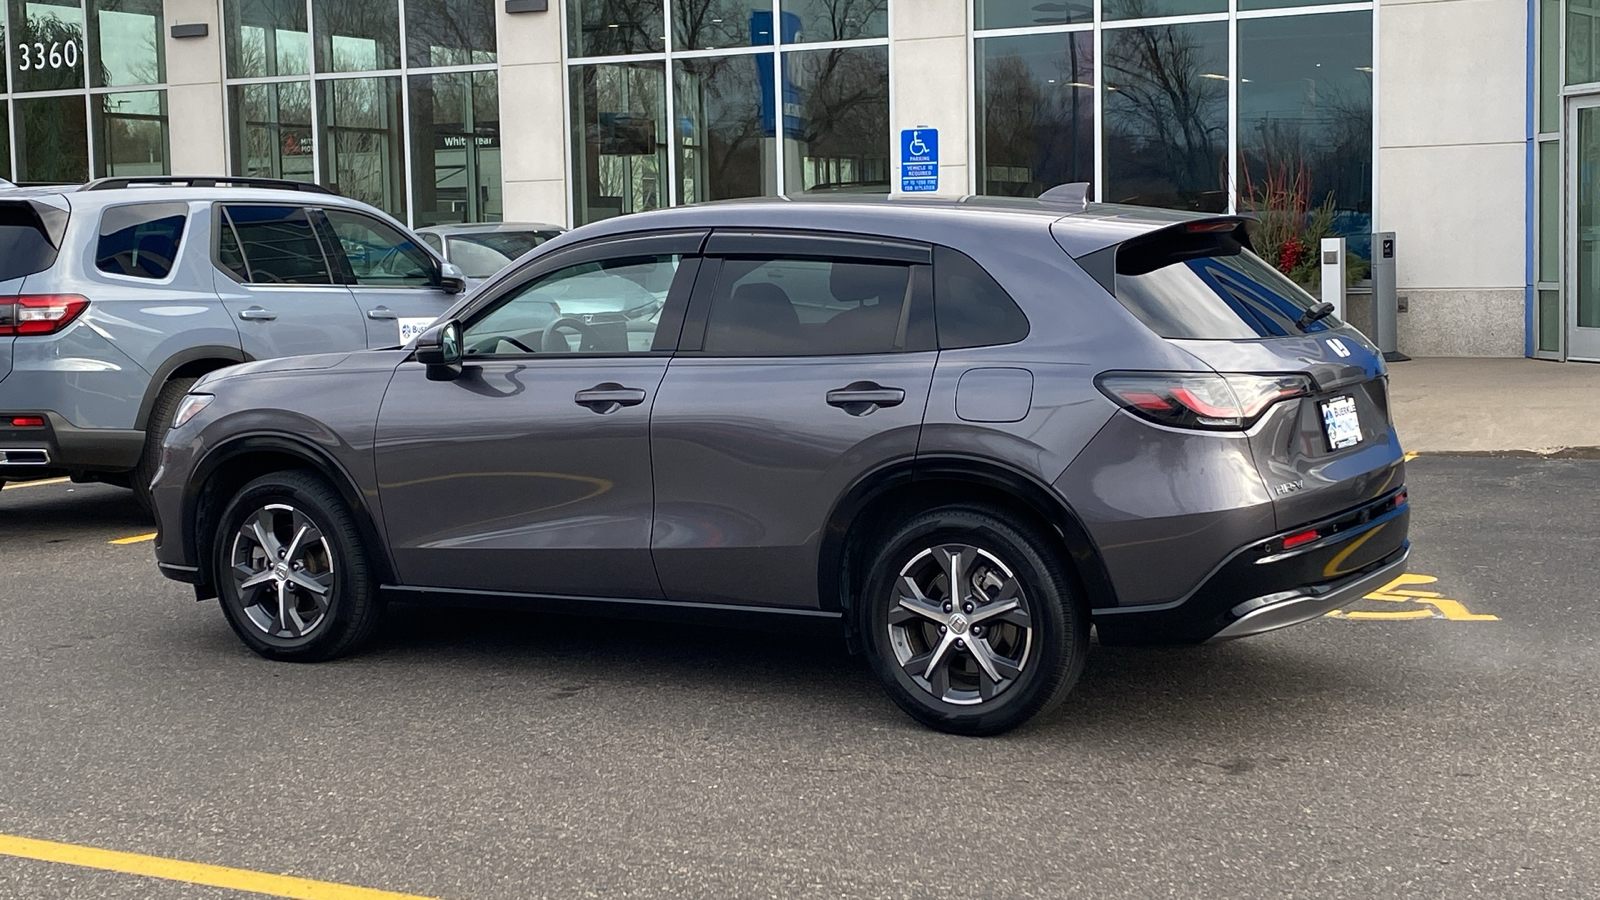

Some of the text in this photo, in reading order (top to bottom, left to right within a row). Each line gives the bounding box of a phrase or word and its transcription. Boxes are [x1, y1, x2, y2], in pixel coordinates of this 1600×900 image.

[19, 40, 77, 70] 3360
[444, 136, 492, 146] Whit ear
